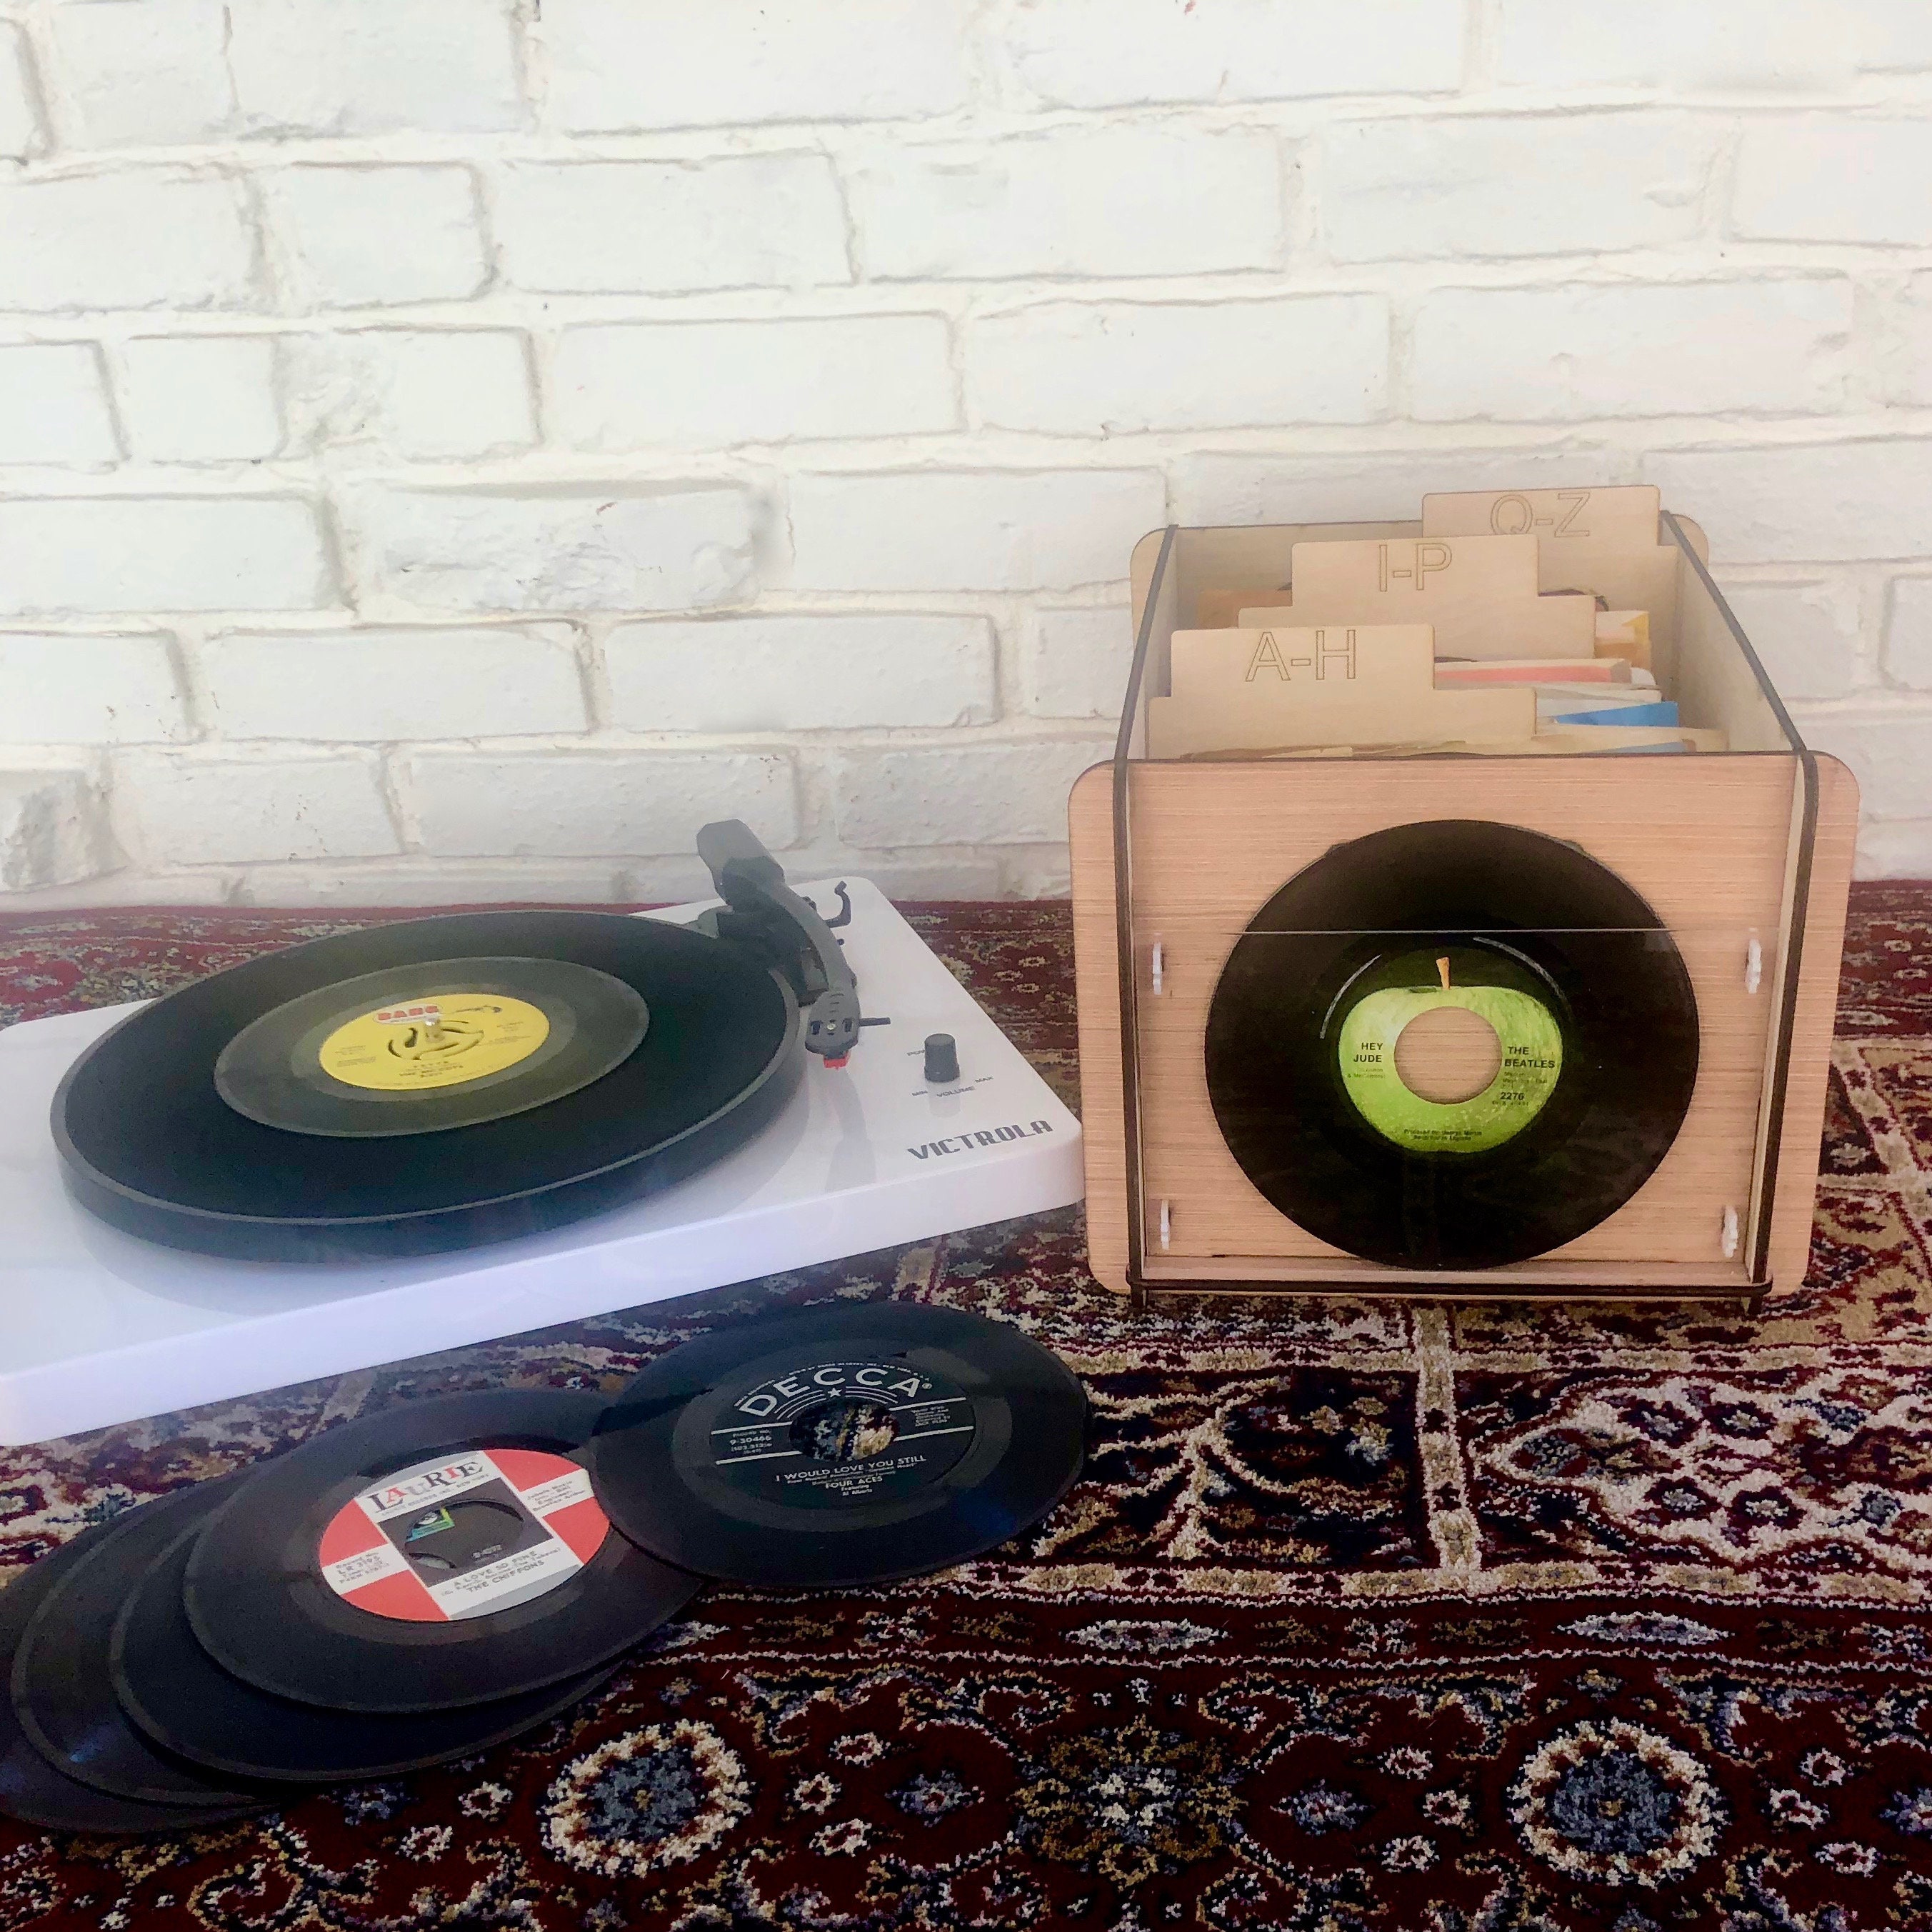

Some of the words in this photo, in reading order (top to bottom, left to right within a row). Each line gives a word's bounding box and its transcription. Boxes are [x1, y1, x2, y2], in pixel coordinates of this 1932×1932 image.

[1490, 491, 1591, 538] Q-Z
[1378, 542, 1453, 592] I-P
[1245, 629, 1357, 682] A-H
[1361, 1042, 1383, 1051] HEY
[1508, 1046, 1529, 1055] THE
[1353, 1054, 1382, 1063] JUDE
[1504, 1058, 1556, 1068] BEATLES
[936, 1086, 975, 1097] VOLUME
[1500, 1092, 1525, 1101] 2276
[907, 1120, 1053, 1160] VICTROLA
[739, 1368, 921, 1416] DECCA
[784, 1469, 831, 1480] WOULD
[834, 1464, 864, 1473] LOVE
[869, 1459, 894, 1468] YOU
[898, 1455, 927, 1464] STILL
[367, 1461, 483, 1513] LAURIE
[826, 1480, 854, 1489] FOUR
[859, 1476, 883, 1484] ACES
[463, 1569, 491, 1583] LOVE
[466, 1582, 490, 1593] THE
[491, 1560, 545, 1584] CHIFFONS
